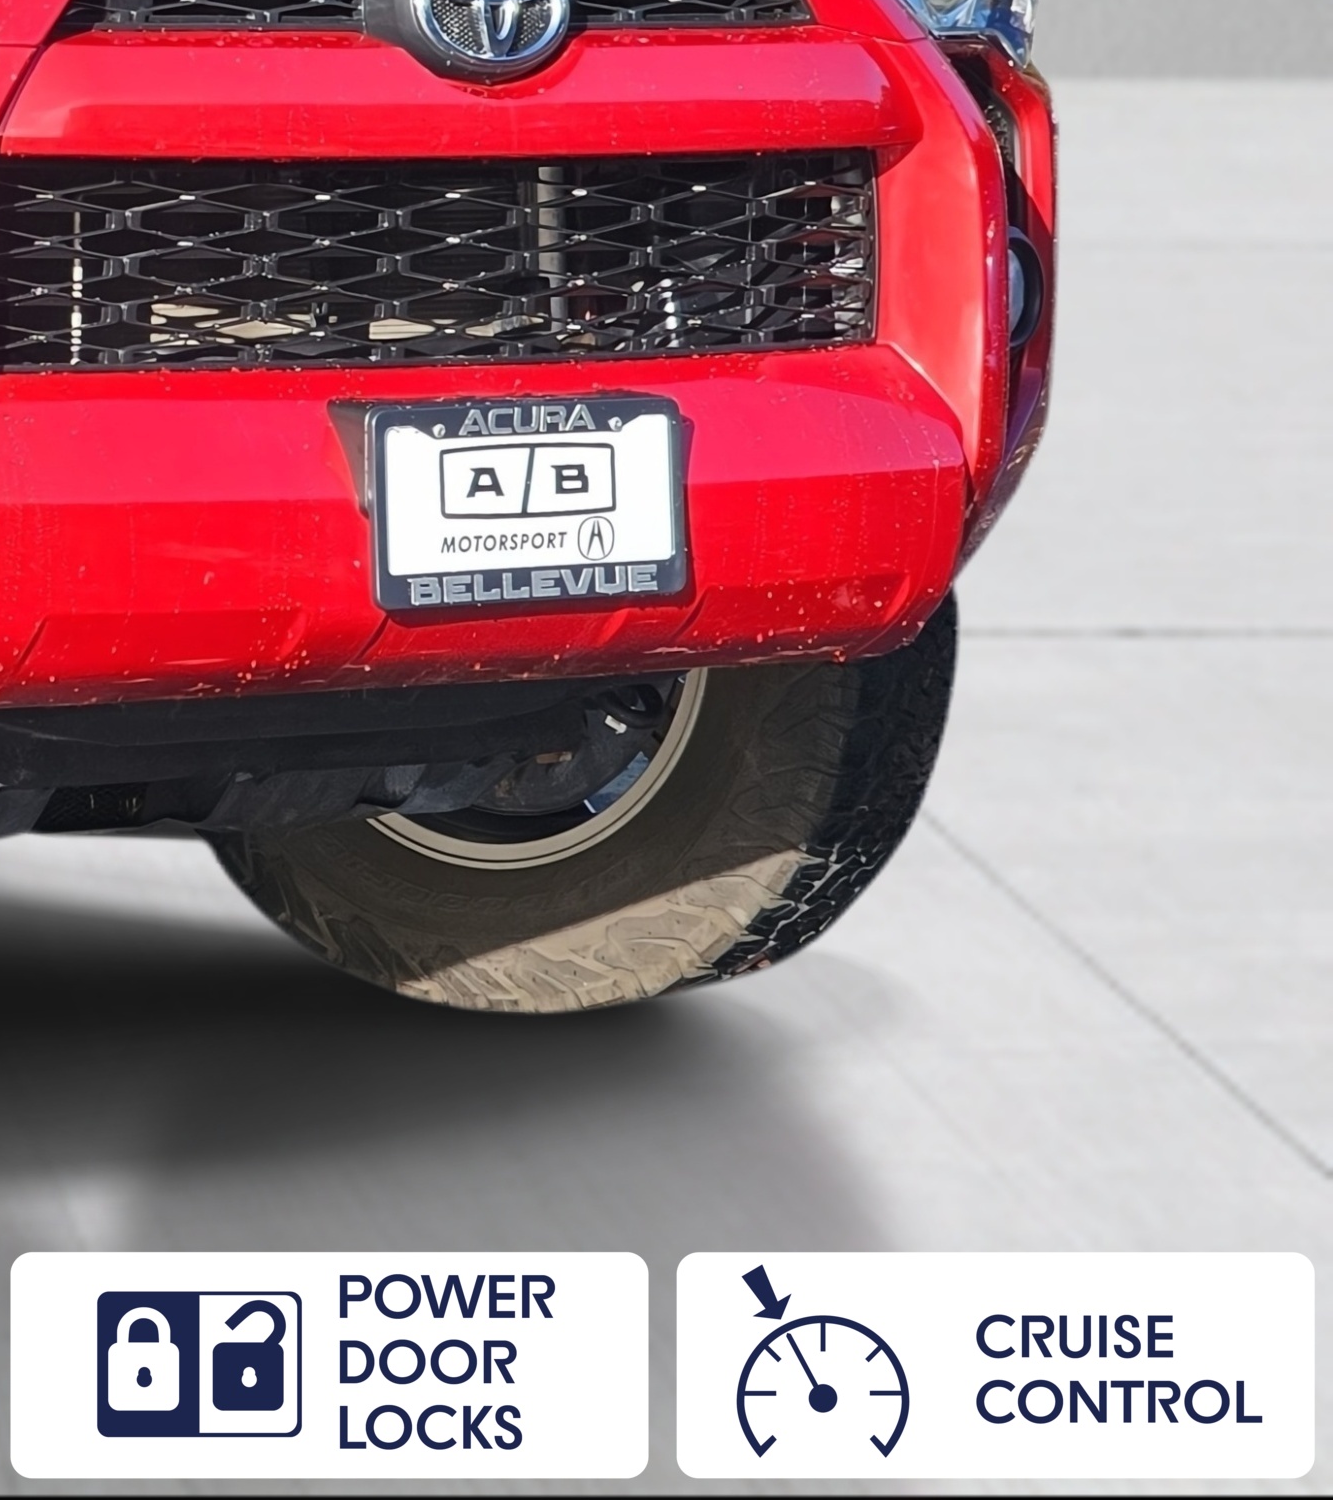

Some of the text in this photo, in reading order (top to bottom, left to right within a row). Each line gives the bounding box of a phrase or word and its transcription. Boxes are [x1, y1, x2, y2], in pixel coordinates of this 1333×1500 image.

[458, 404, 596, 436] ACURA
[466, 464, 589, 498] A B
[441, 531, 568, 553] MOTORSPORT
[408, 564, 658, 606] BELLEVUE
